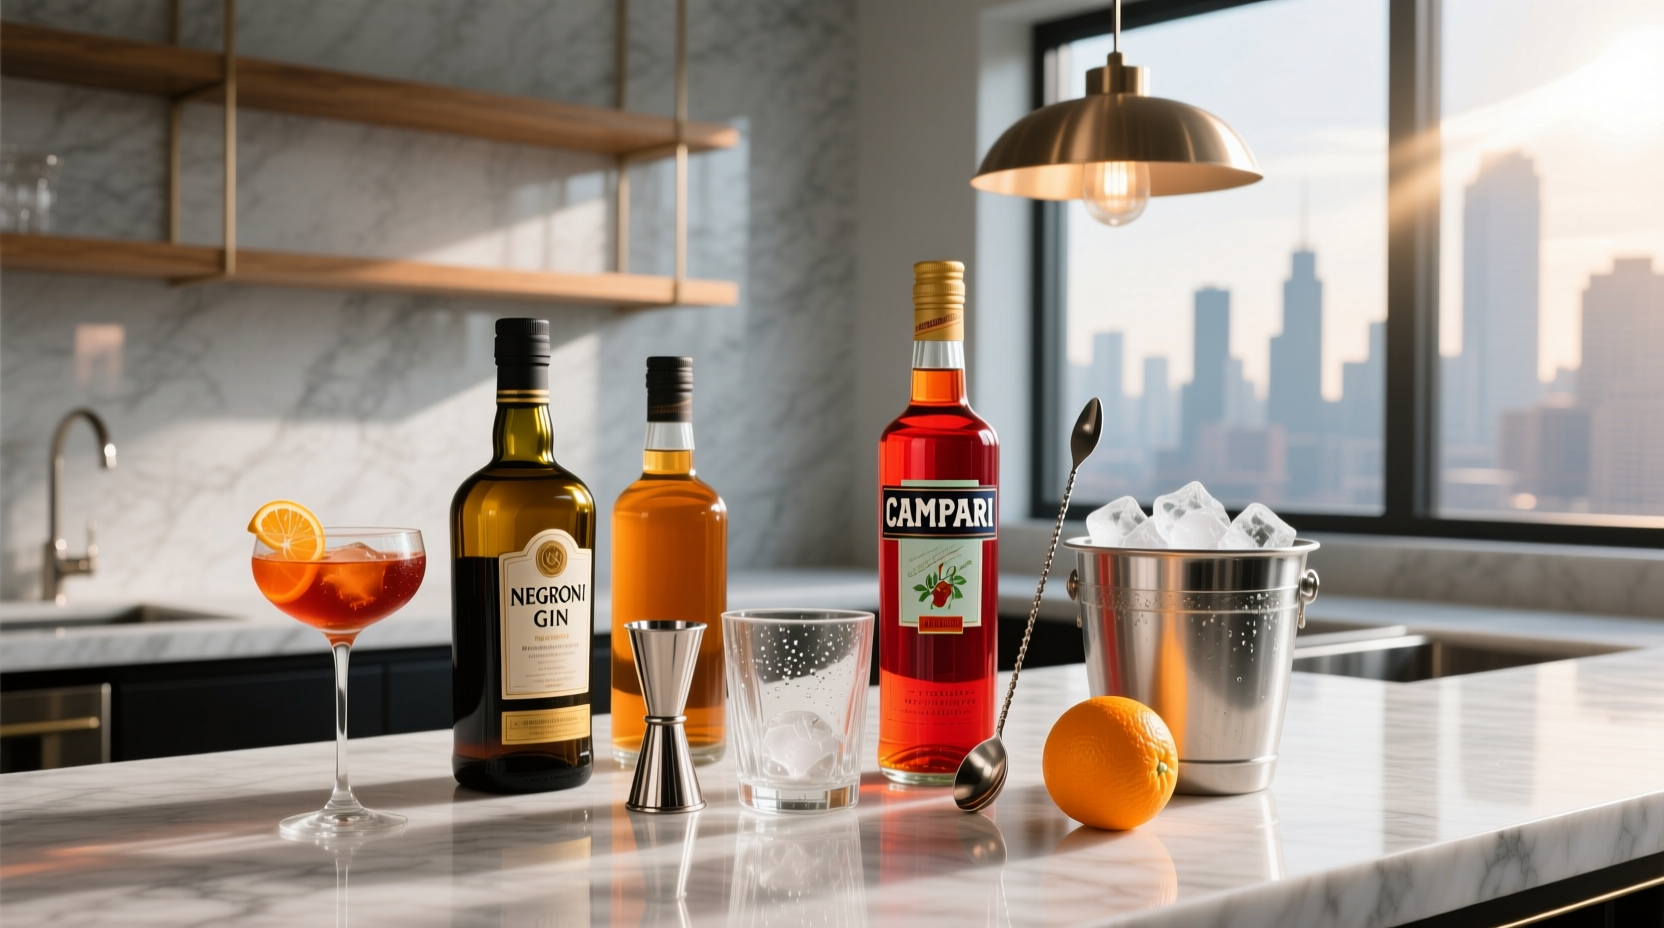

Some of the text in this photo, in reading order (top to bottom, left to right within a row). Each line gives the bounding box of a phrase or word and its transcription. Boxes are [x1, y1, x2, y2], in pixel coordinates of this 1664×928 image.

[886, 497, 994, 527] CAMPARI
[511, 584, 586, 606] NEGRONI
[533, 608, 568, 628] GIN
